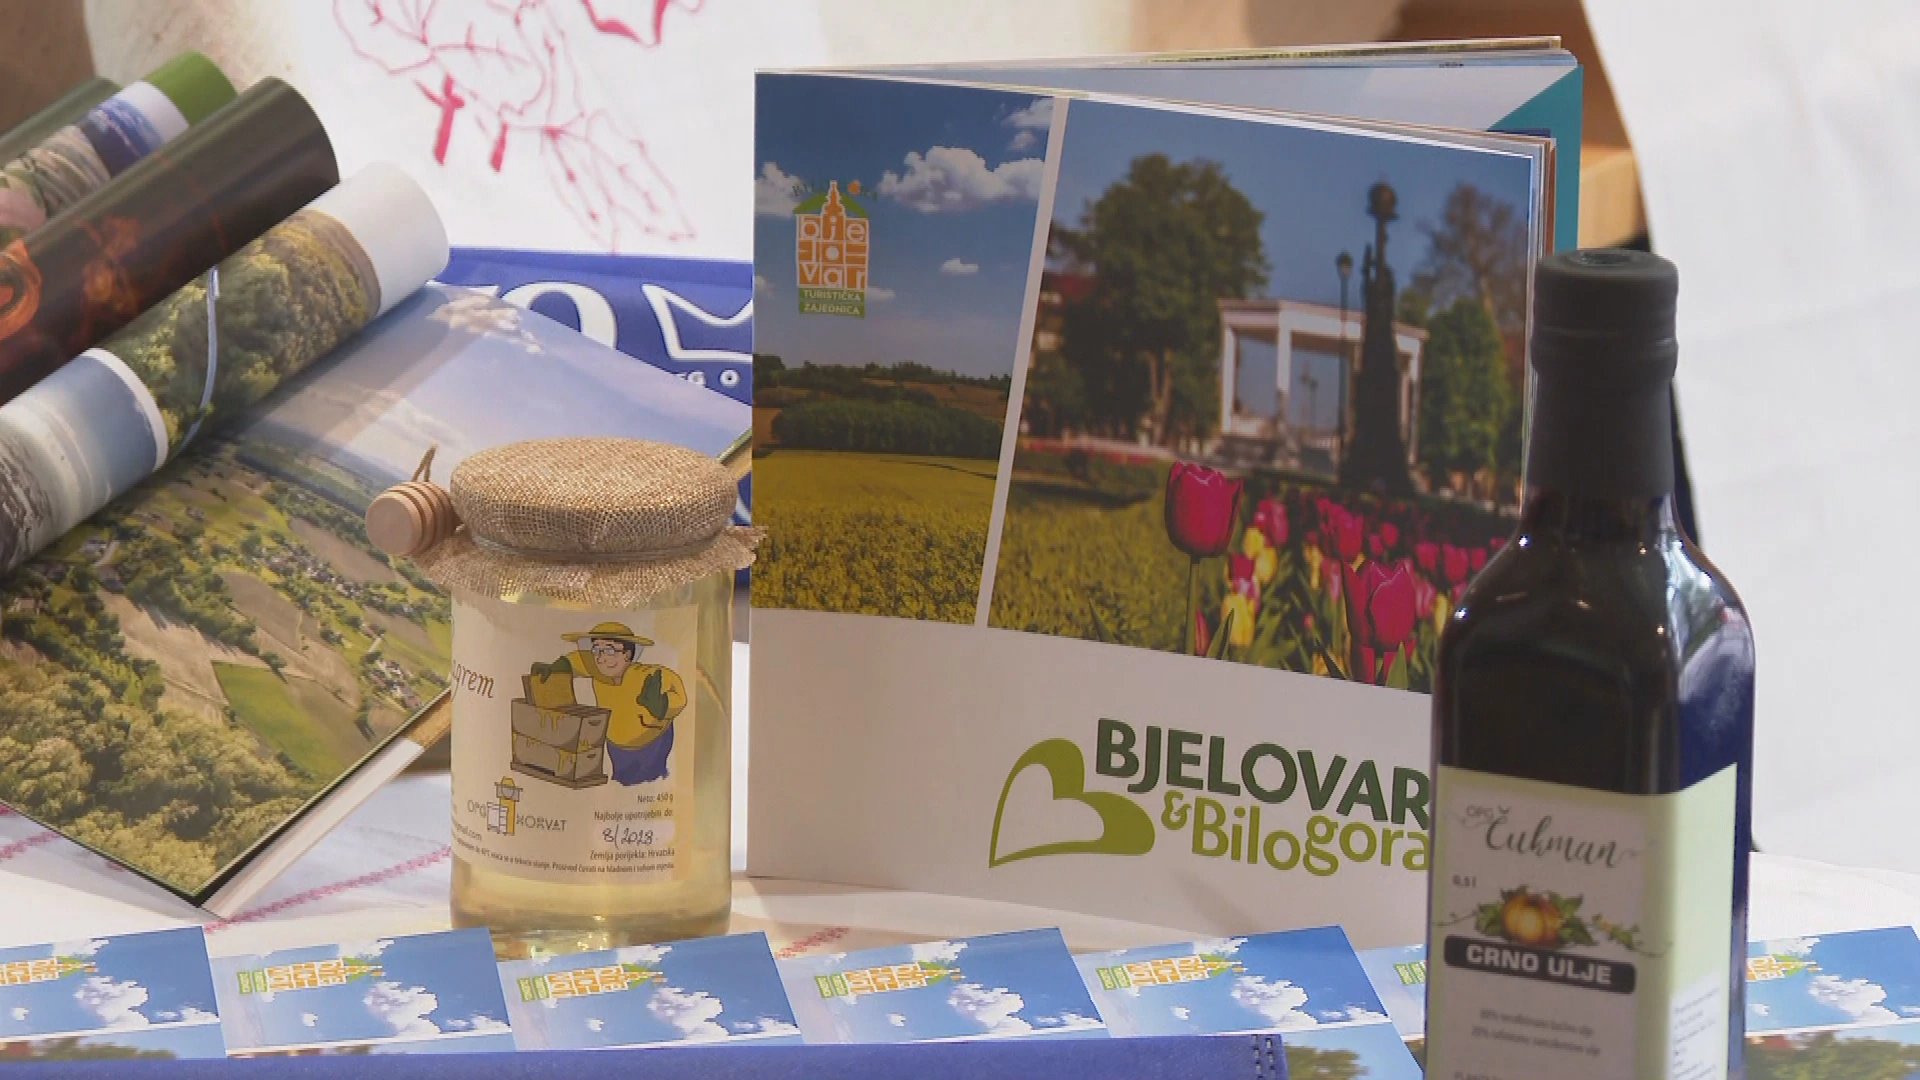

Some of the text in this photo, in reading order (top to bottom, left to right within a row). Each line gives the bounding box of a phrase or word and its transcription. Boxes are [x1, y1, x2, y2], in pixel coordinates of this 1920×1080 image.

[451, 660, 494, 702] grem
[1096, 718, 1429, 830] BJELOVAR
[1466, 945, 1612, 984] CRNO ULJE
